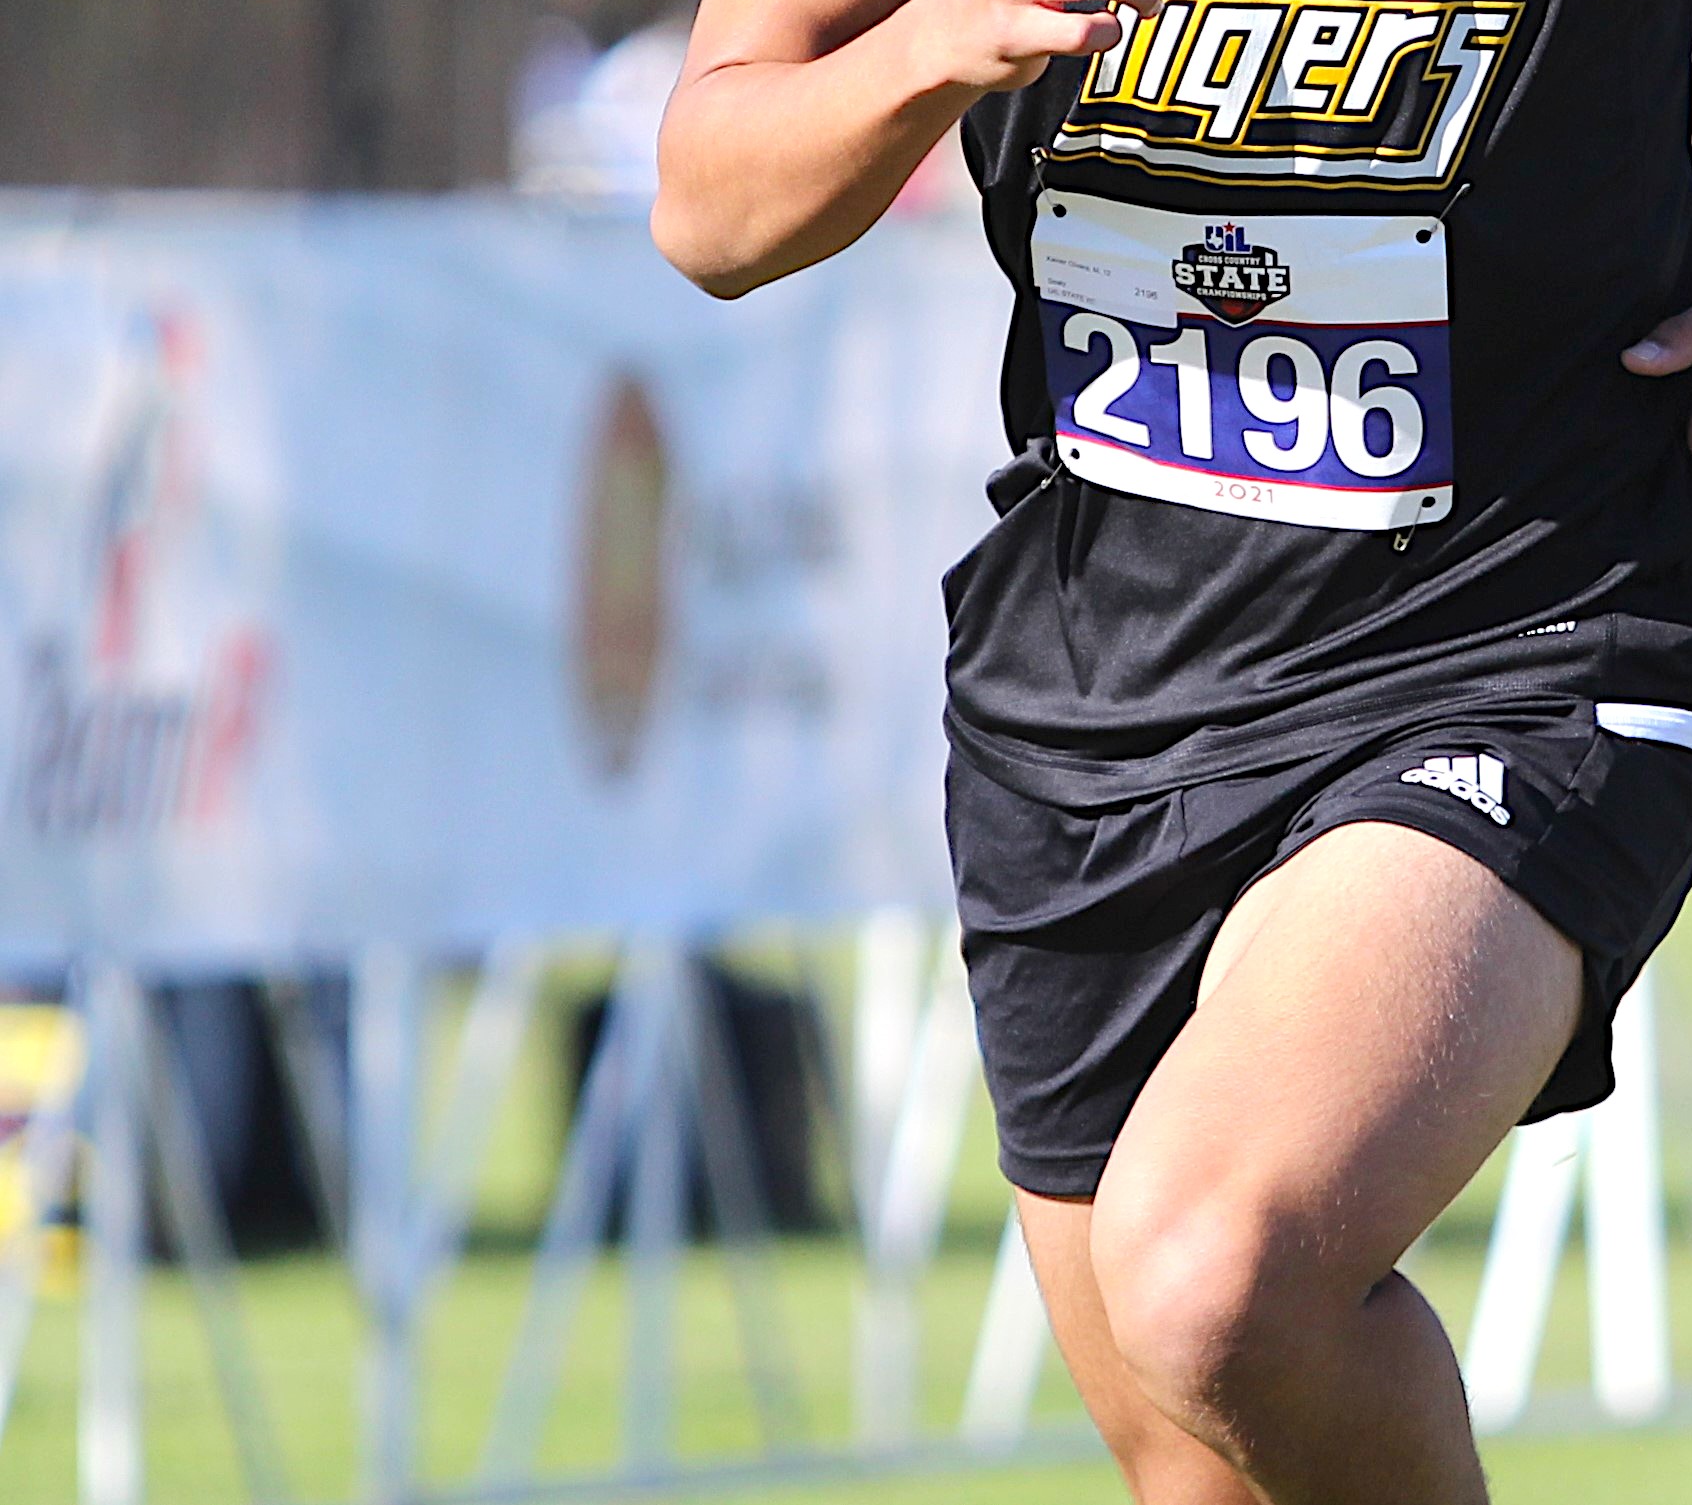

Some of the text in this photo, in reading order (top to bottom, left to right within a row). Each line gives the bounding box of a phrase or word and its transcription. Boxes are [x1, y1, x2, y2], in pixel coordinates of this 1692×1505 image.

[1198, 254, 1261, 266] CROSS COUNTRY
[1174, 262, 1287, 293] STATE
[1134, 286, 1158, 301] 2196
[1196, 287, 1267, 301] CHAMPIONSHIPS
[1062, 311, 1424, 478] 2196
[1214, 481, 1274, 505] 2021
